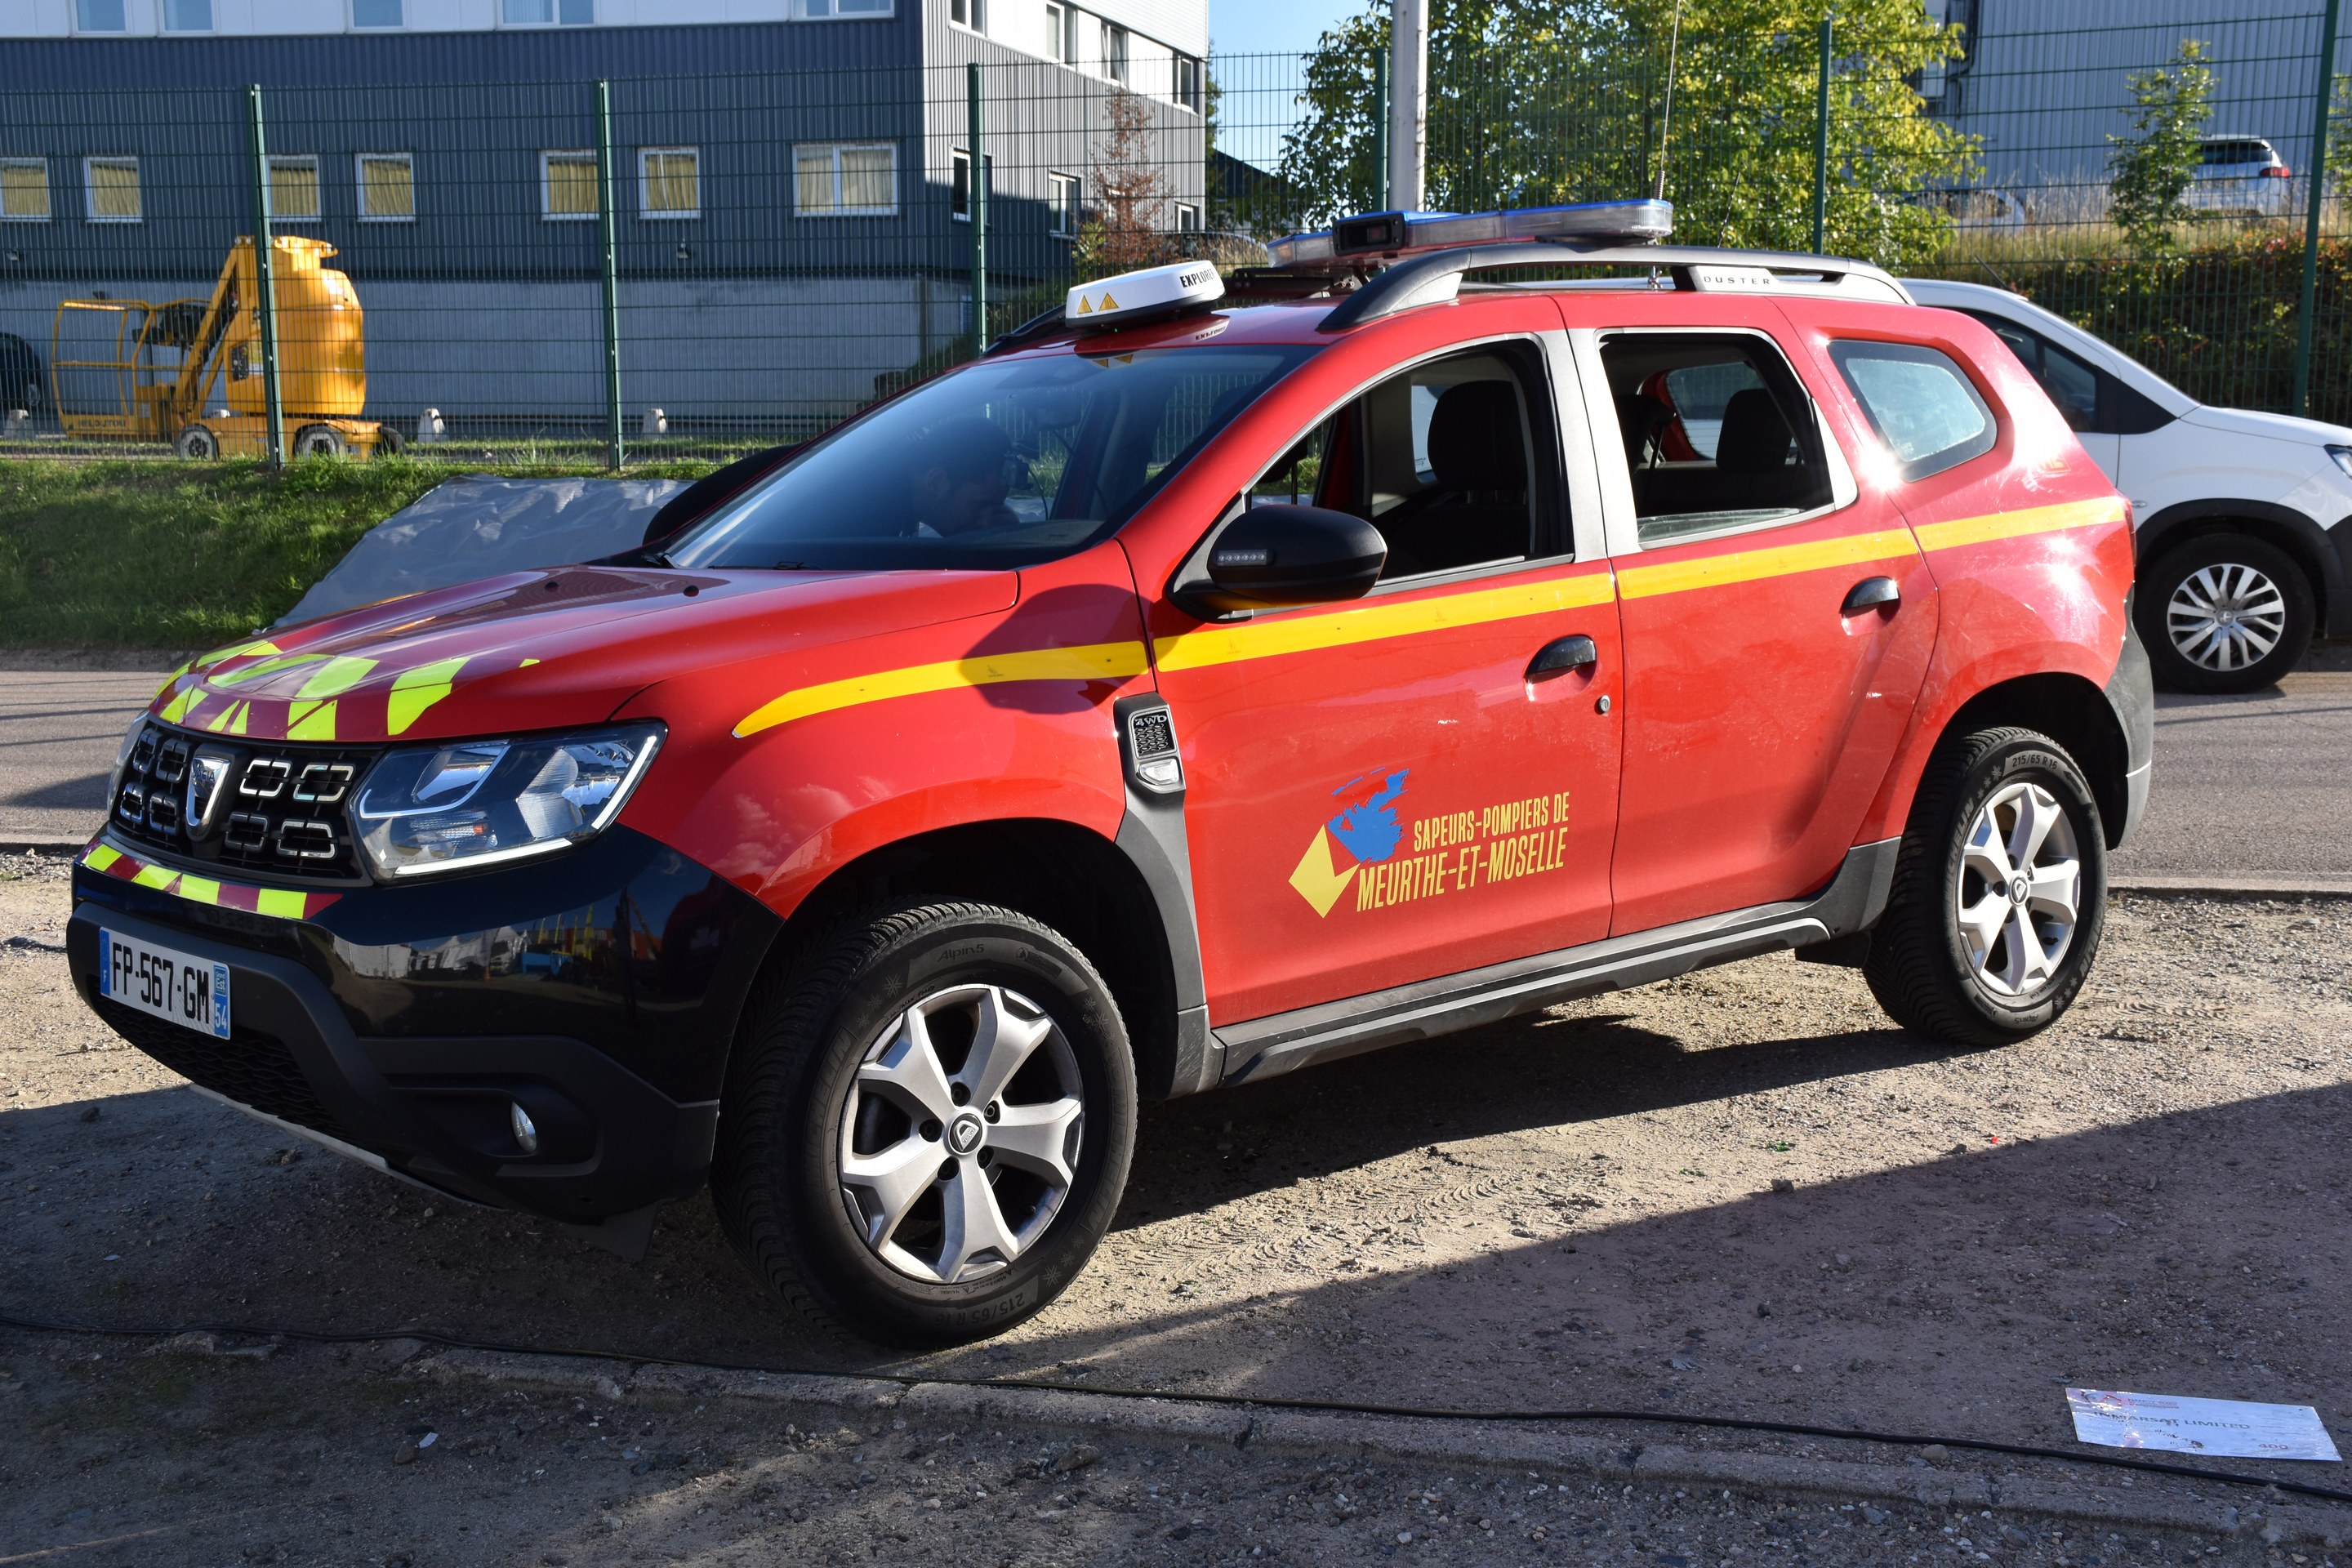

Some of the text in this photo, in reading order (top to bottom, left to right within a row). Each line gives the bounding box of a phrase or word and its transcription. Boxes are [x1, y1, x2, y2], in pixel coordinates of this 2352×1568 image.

[1704, 275, 1771, 286] DUSTER
[1134, 714, 1168, 727] 4WD
[2012, 755, 2041, 768] 215/65
[2042, 758, 2048, 766] R
[1414, 792, 1570, 852] SAPEURS-POMPIERS DE
[1356, 827, 1568, 912] MEURTHE-ET-MOSELLE
[113, 942, 209, 1025] FP-567-GM
[215, 1003, 228, 1031] 54
[956, 1312, 967, 1325] R
[970, 1292, 1026, 1325] 215/65
[2185, 1419, 2251, 1430] LIMITED
